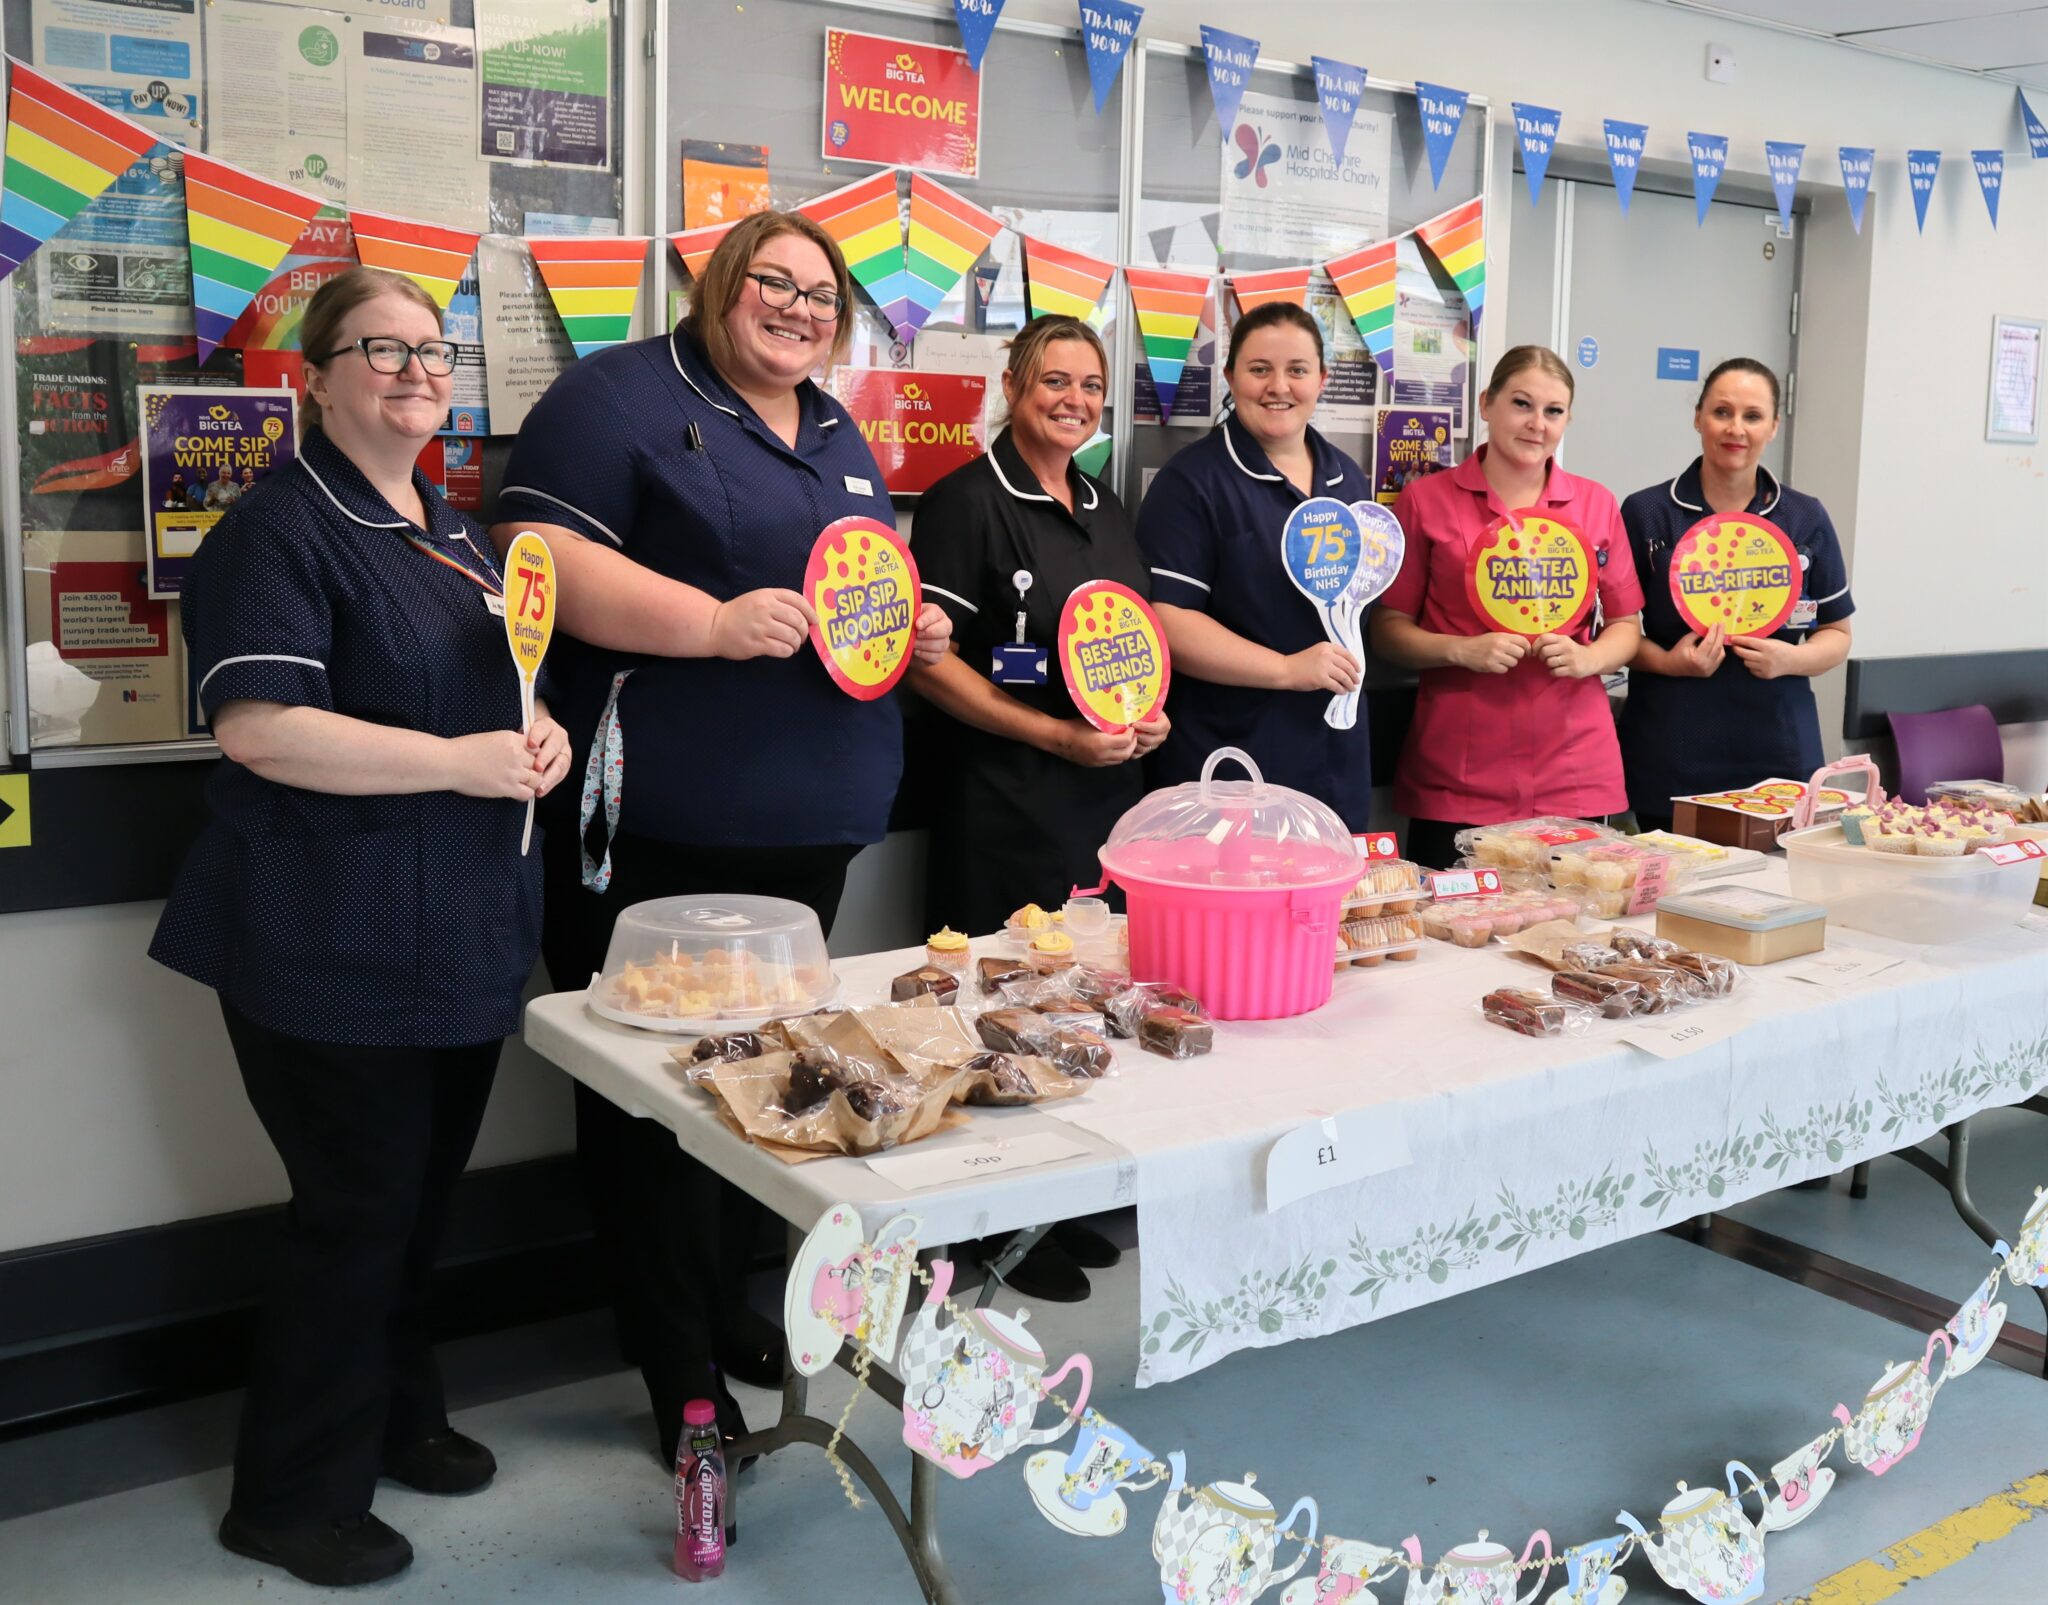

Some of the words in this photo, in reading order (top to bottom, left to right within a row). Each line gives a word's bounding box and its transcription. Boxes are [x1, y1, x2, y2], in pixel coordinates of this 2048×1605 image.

[1082, 8, 1134, 36] THANK
[513, 41, 529, 53] UP
[532, 44, 567, 59] NOW!
[1090, 32, 1122, 53] YOU
[1205, 43, 1251, 68] THANK
[886, 69, 904, 81] BIG
[905, 71, 925, 85] TEA
[1213, 66, 1241, 86] YOU
[1317, 72, 1361, 95] THANK
[133, 93, 148, 105] PAY
[151, 85, 167, 99] UP
[165, 99, 187, 114] NOW!
[839, 83, 968, 125] WELCOME
[1324, 95, 1351, 113] YOU
[1420, 97, 1462, 119] THANK
[1239, 103, 1264, 116] Please
[1266, 108, 1297, 121] support
[1299, 113, 1316, 124] your
[1517, 117, 1556, 137] THANK
[1286, 144, 1310, 161] Mid
[1313, 148, 1361, 168] Chehire
[308, 159, 324, 173] UP
[289, 169, 305, 181] PAY
[323, 174, 346, 190] NOW!
[1286, 163, 1339, 182] Hospitals
[1342, 168, 1380, 190] Charity
[300, 226, 339, 243] PAY
[499, 291, 523, 299] Please
[502, 303, 533, 311] personal
[33, 373, 64, 383] TRADE
[67, 375, 107, 385] UNIONS:
[507, 367, 555, 375] details/moved
[33, 383, 57, 392] Know
[59, 385, 78, 394] your
[505, 379, 528, 387] please
[32, 391, 108, 411] FACTS
[894, 400, 912, 410] BIG
[914, 401, 932, 411] TEA
[71, 411, 91, 420] from
[93, 411, 107, 421] the
[199, 421, 219, 431] BIG
[220, 421, 243, 431] TEA
[859, 419, 974, 446] WELCOME
[1402, 428, 1414, 436] BIG
[1414, 429, 1426, 437] TEA
[174, 436, 235, 452] COME
[240, 437, 269, 452] SIP
[1390, 439, 1421, 451] COME
[1423, 440, 1439, 451] SIP
[174, 452, 229, 468] WITH
[235, 452, 270, 468] ME!
[1389, 451, 1418, 462] WITH
[107, 464, 130, 473] unite
[1303, 511, 1338, 524] Happy
[1358, 511, 1389, 530] Happy
[1301, 523, 1352, 565] 75th
[1760, 547, 1775, 555] TEA
[520, 547, 545, 568] Happy
[874, 564, 886, 575] BIG
[885, 562, 900, 573] TEA
[1304, 565, 1349, 580] Birthday
[1491, 560, 1576, 578] PAR-TEA
[1315, 578, 1340, 591] NHS
[1681, 567, 1789, 592] TEA-RIFFIC!
[517, 567, 551, 621] 75th
[1495, 579, 1572, 597] ANIMAL
[83, 594, 118, 602] 435,000
[837, 589, 865, 617] SIP
[869, 581, 896, 607] SIP
[62, 605, 102, 613] members
[96, 616, 125, 624] largest
[830, 605, 908, 646] HOORAY!
[1119, 621, 1130, 630] BIG
[1130, 618, 1142, 627] TEA
[63, 627, 95, 635] nursing
[514, 622, 545, 643] Birthday
[63, 638, 80, 646] and
[81, 637, 134, 646] professional
[135, 636, 157, 645] body
[520, 642, 538, 658] NHS
[1080, 633, 1150, 667] BES-TEA
[1086, 655, 1154, 690] FRIENDS
[1369, 841, 1378, 853] £
[1670, 1026, 1704, 1042] £1.50
[963, 1154, 1002, 1167] 50p
[1317, 1145, 1337, 1166] £1
[699, 1473, 714, 1544] Lucozade
